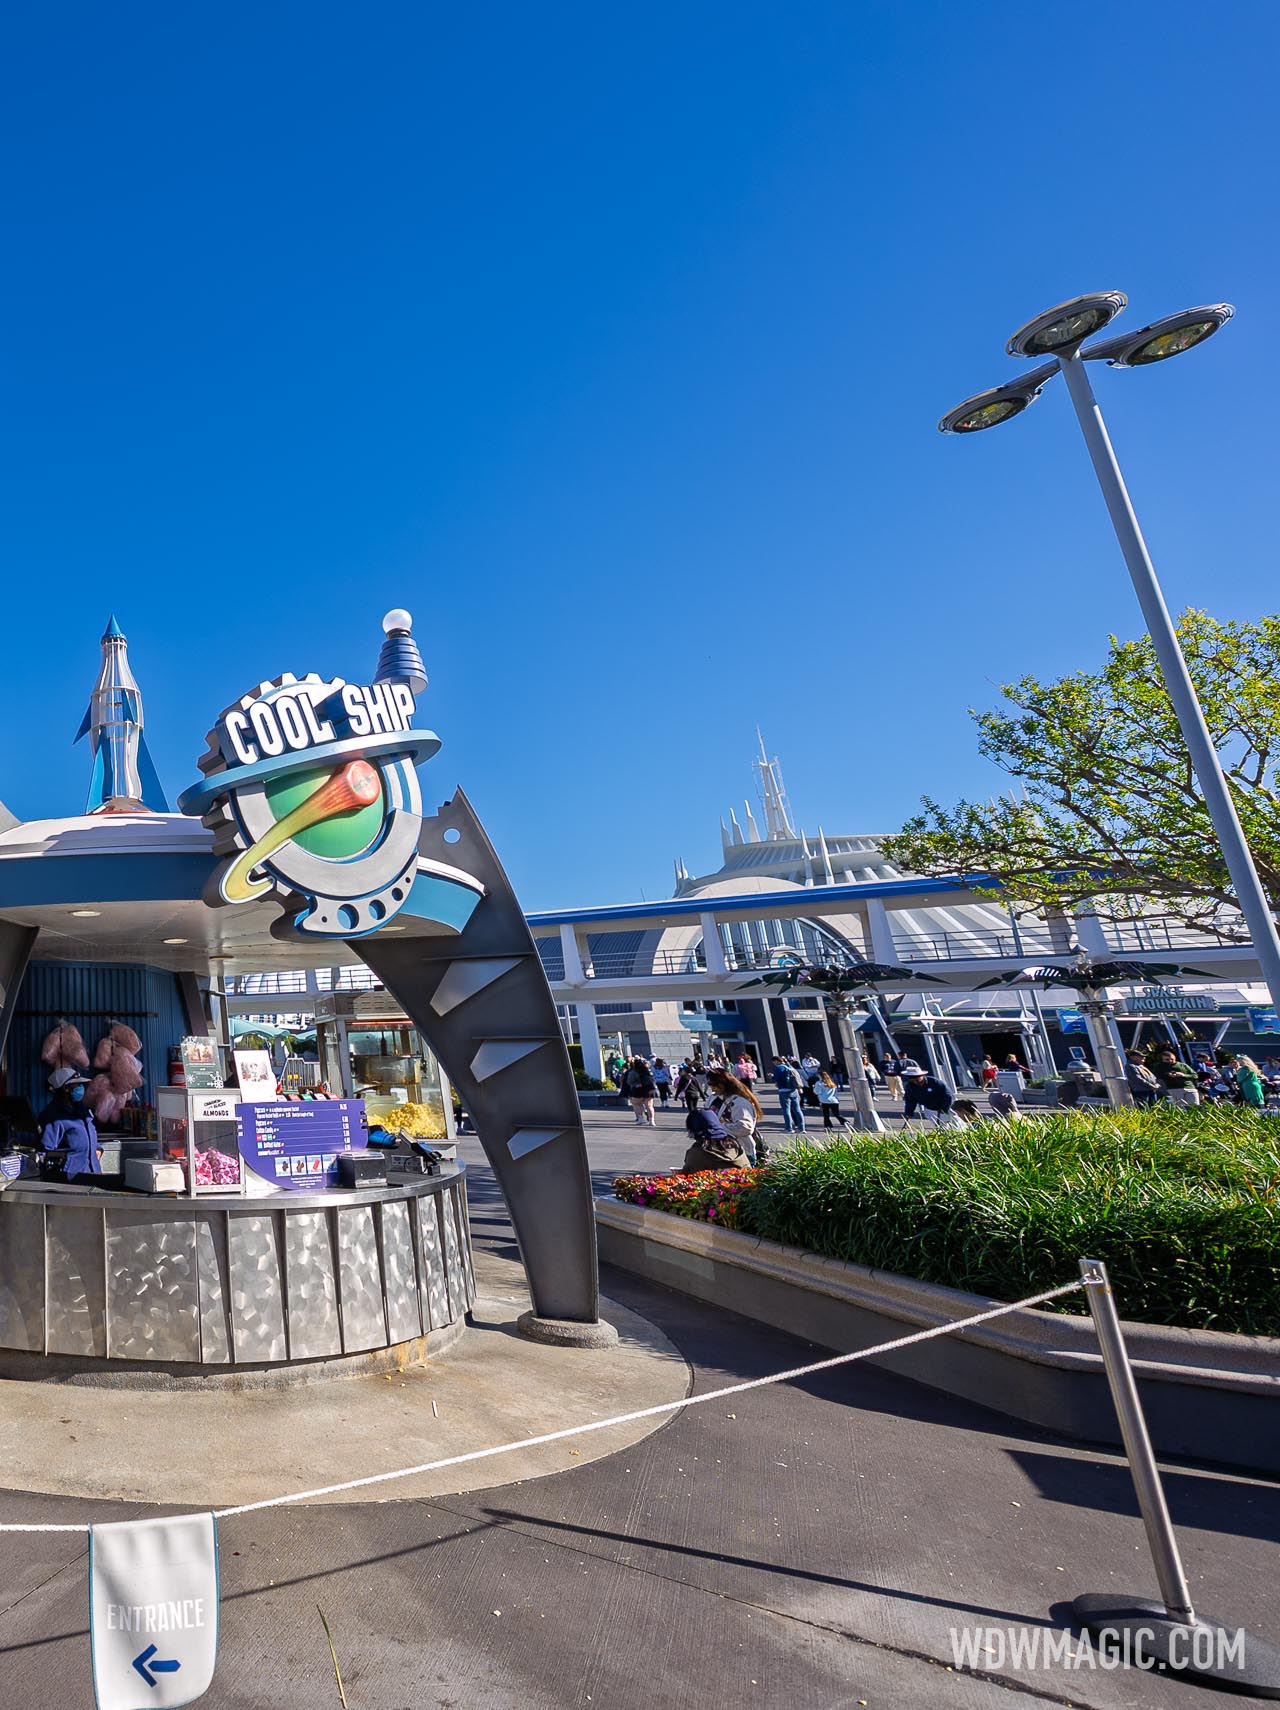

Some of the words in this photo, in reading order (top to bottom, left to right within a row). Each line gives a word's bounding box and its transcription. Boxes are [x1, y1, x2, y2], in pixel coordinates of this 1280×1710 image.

[224, 692, 337, 765] COOL
[341, 682, 417, 736] SHIP
[1142, 985, 1185, 998] SPACE
[1132, 997, 1207, 1011] MOUNTAIN
[107, 1598, 205, 1632] ENTRANCE
